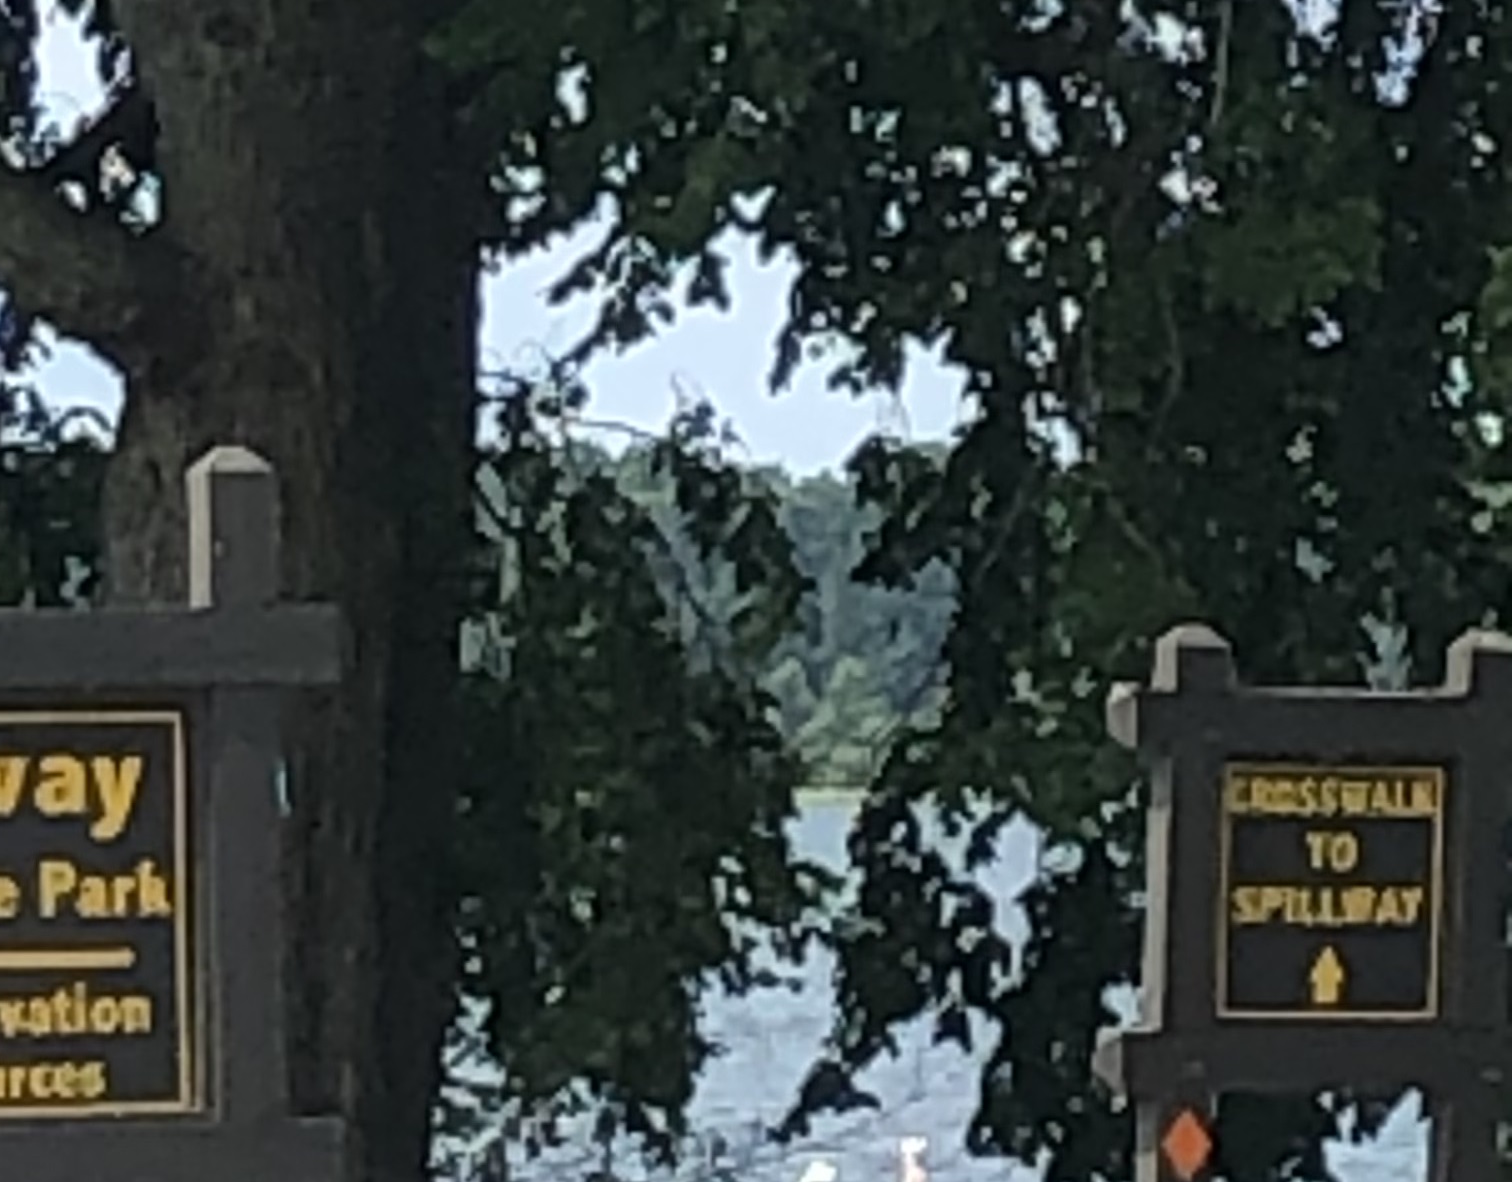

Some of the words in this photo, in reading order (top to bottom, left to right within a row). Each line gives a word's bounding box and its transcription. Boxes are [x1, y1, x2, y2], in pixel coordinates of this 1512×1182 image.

[1226, 775, 1436, 817] CROSSWALK
[1305, 830, 1358, 873] TO
[38, 860, 172, 920] Park
[1231, 886, 1423, 926] SPILLWAY
